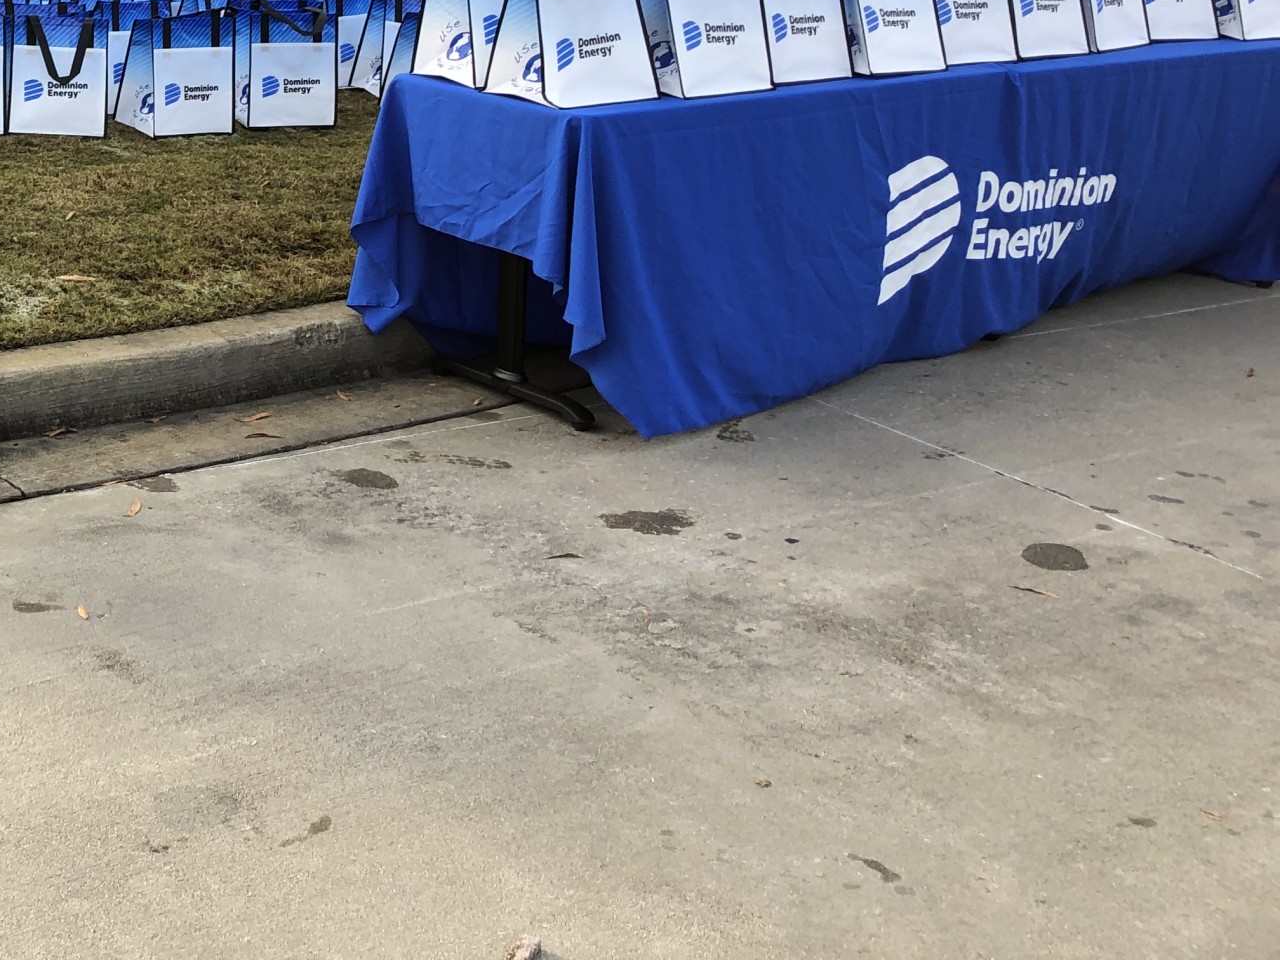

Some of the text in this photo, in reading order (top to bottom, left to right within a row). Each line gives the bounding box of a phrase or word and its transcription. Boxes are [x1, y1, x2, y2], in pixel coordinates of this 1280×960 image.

[953, 0, 988, 11] Dominion
[789, 13, 825, 25] Dominion
[879, 7, 916, 19] Dominion
[704, 22, 745, 34] Dominion
[577, 32, 621, 48] Dominion
[283, 78, 320, 87] Dominion
[184, 84, 219, 94] Dominion
[975, 167, 1116, 212] Dominion
